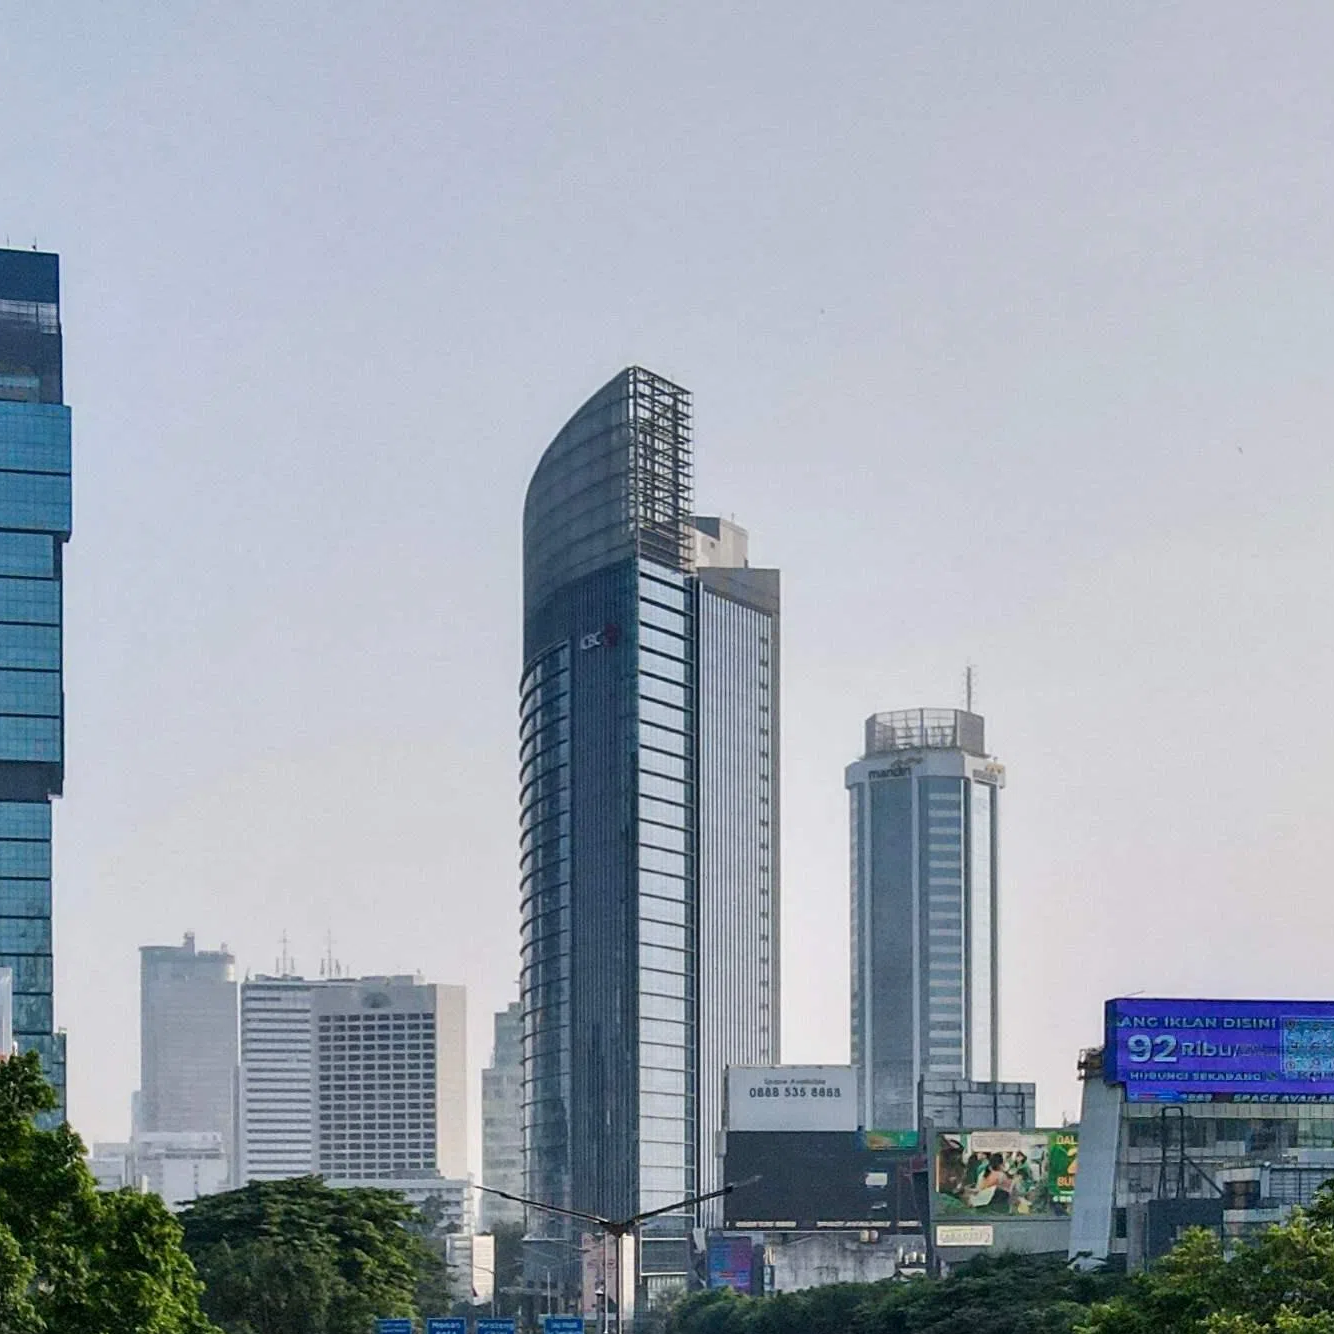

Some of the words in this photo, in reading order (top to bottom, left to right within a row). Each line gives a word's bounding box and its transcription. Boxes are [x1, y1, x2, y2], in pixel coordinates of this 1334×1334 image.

[1164, 1016, 1217, 1029] IKLAN
[1223, 1017, 1276, 1029] DISINI
[1128, 1034, 1178, 1063] 92
